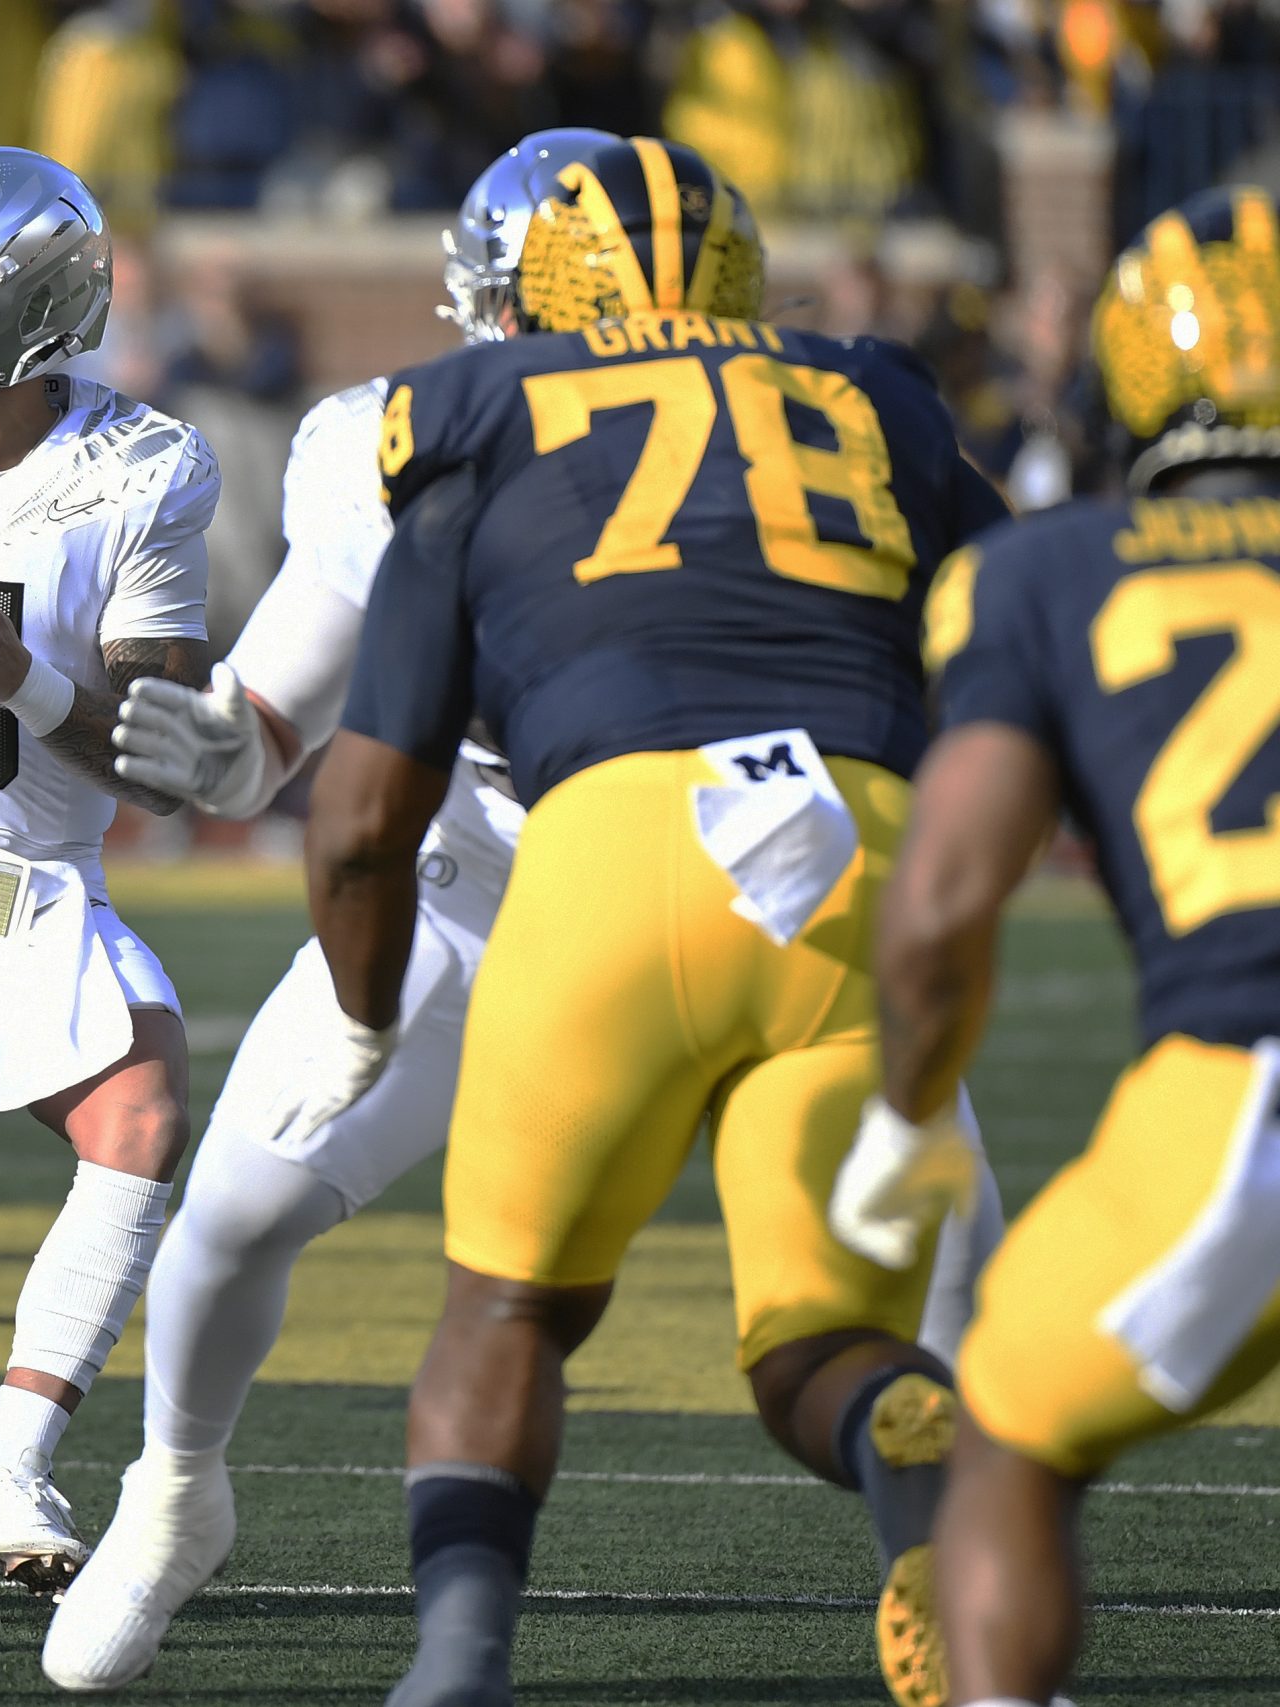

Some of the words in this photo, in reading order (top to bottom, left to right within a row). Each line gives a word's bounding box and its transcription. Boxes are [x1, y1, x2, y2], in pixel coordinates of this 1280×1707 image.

[584, 311, 784, 358] GRANT
[522, 354, 918, 601] 78
[732, 743, 806, 782] M
[1089, 560, 1280, 939] 2
